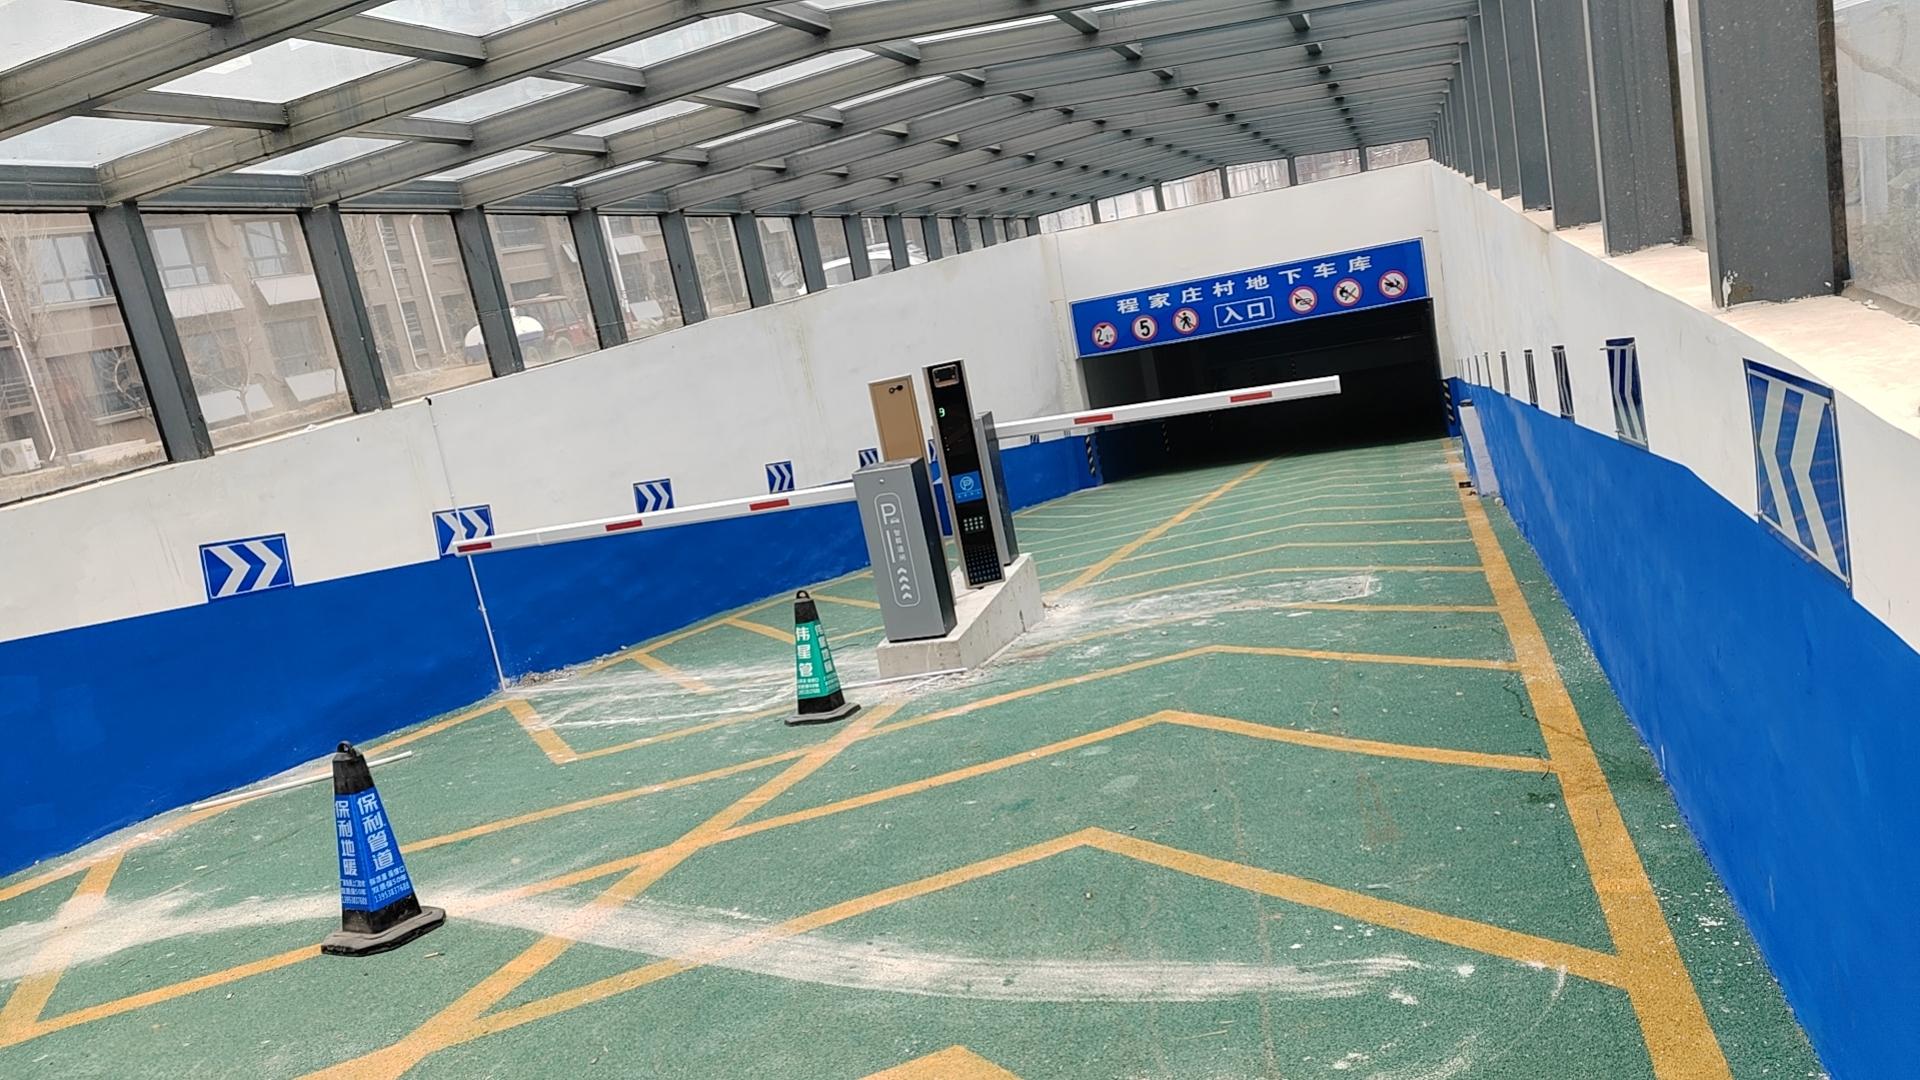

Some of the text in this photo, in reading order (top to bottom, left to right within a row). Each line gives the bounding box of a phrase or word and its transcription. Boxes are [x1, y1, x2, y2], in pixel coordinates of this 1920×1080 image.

[1117, 255, 1372, 314] 程家庄村地下车库
[1139, 320, 1151, 337] 5
[1222, 303, 1266, 324] 入口
[880, 502, 896, 525] P
[335, 799, 358, 876] 保利地暖
[357, 792, 394, 872] 保利管道
